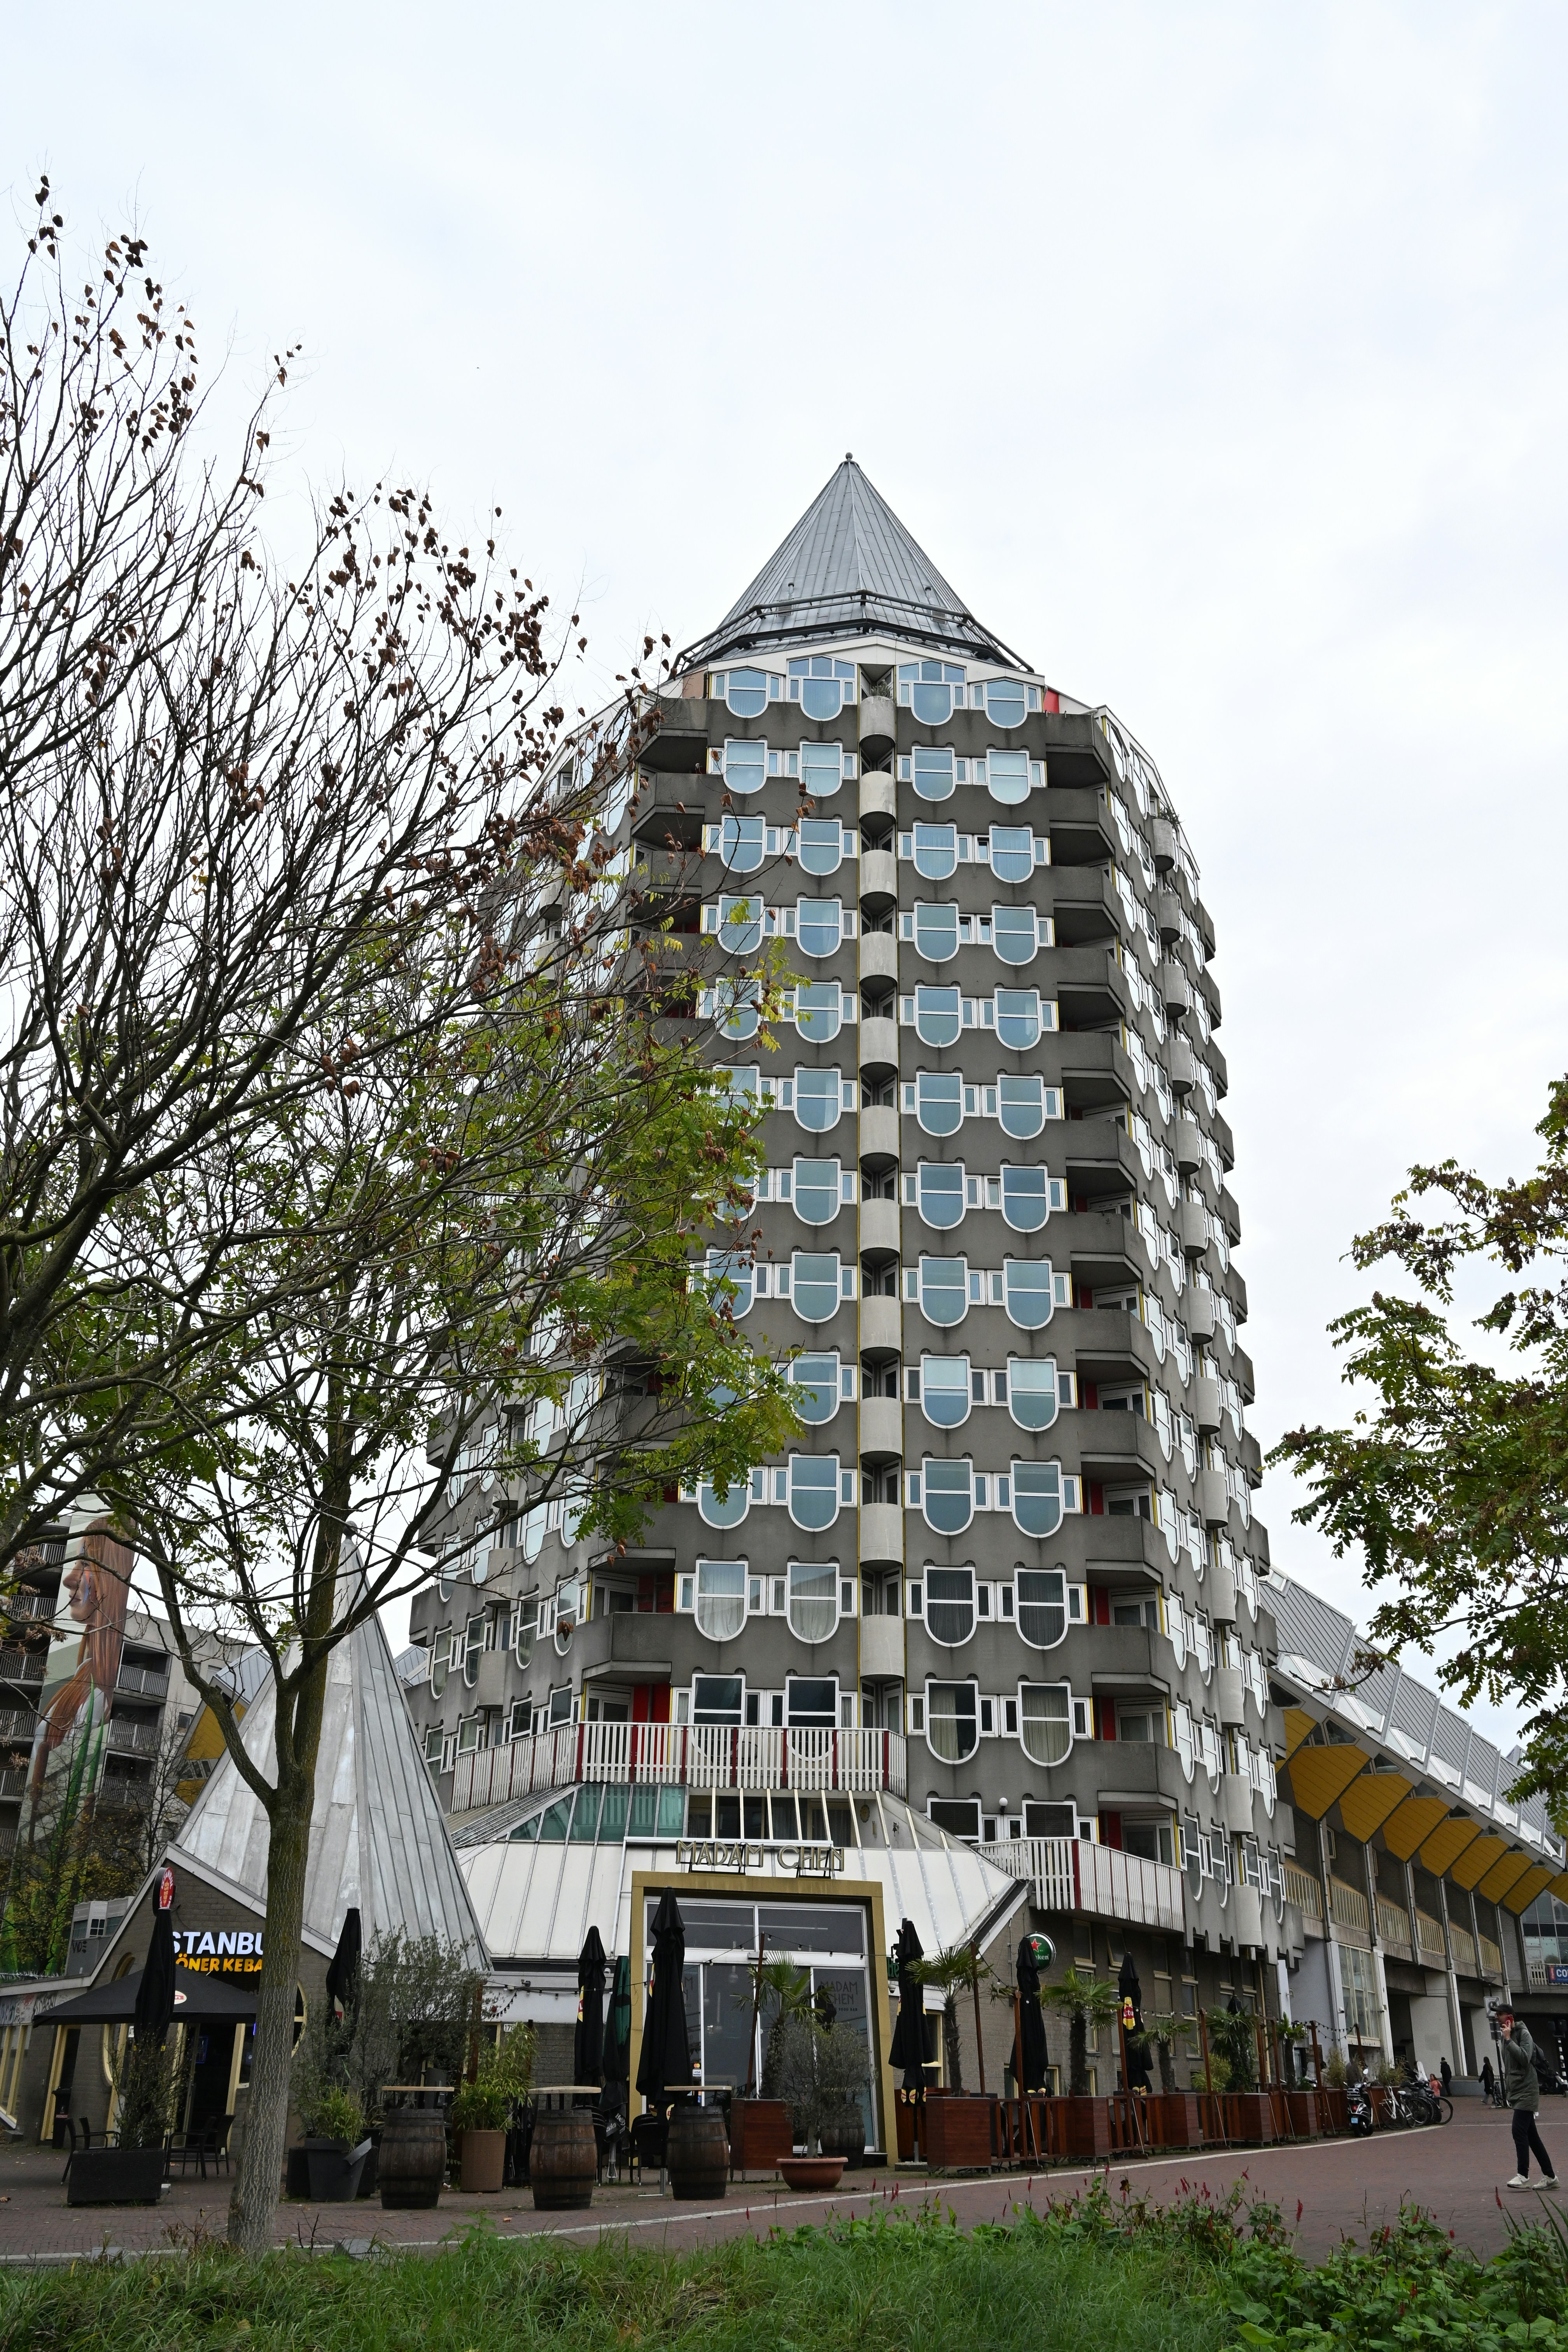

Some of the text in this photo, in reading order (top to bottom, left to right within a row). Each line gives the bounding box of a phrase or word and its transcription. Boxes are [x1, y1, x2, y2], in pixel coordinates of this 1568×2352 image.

[676, 1840, 844, 1871] MADAM CHEN
[1556, 1969, 1568, 1977] CO
[820, 1981, 858, 1995] MADAM
[833, 1993, 854, 2004] HEN
